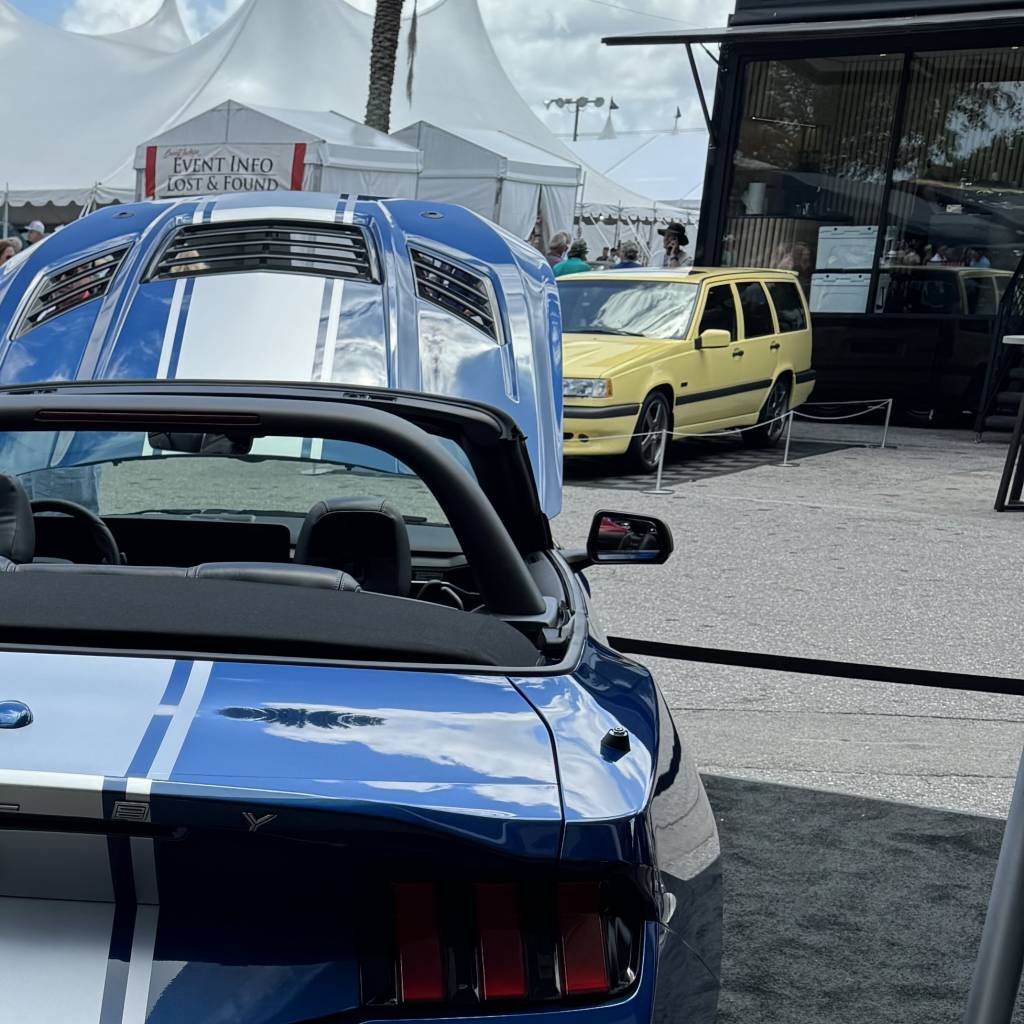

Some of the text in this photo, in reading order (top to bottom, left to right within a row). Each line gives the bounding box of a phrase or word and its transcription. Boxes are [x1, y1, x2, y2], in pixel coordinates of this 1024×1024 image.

[173, 155, 274, 174] EVENT INFO
[167, 175, 279, 192] LOST & FOUND
